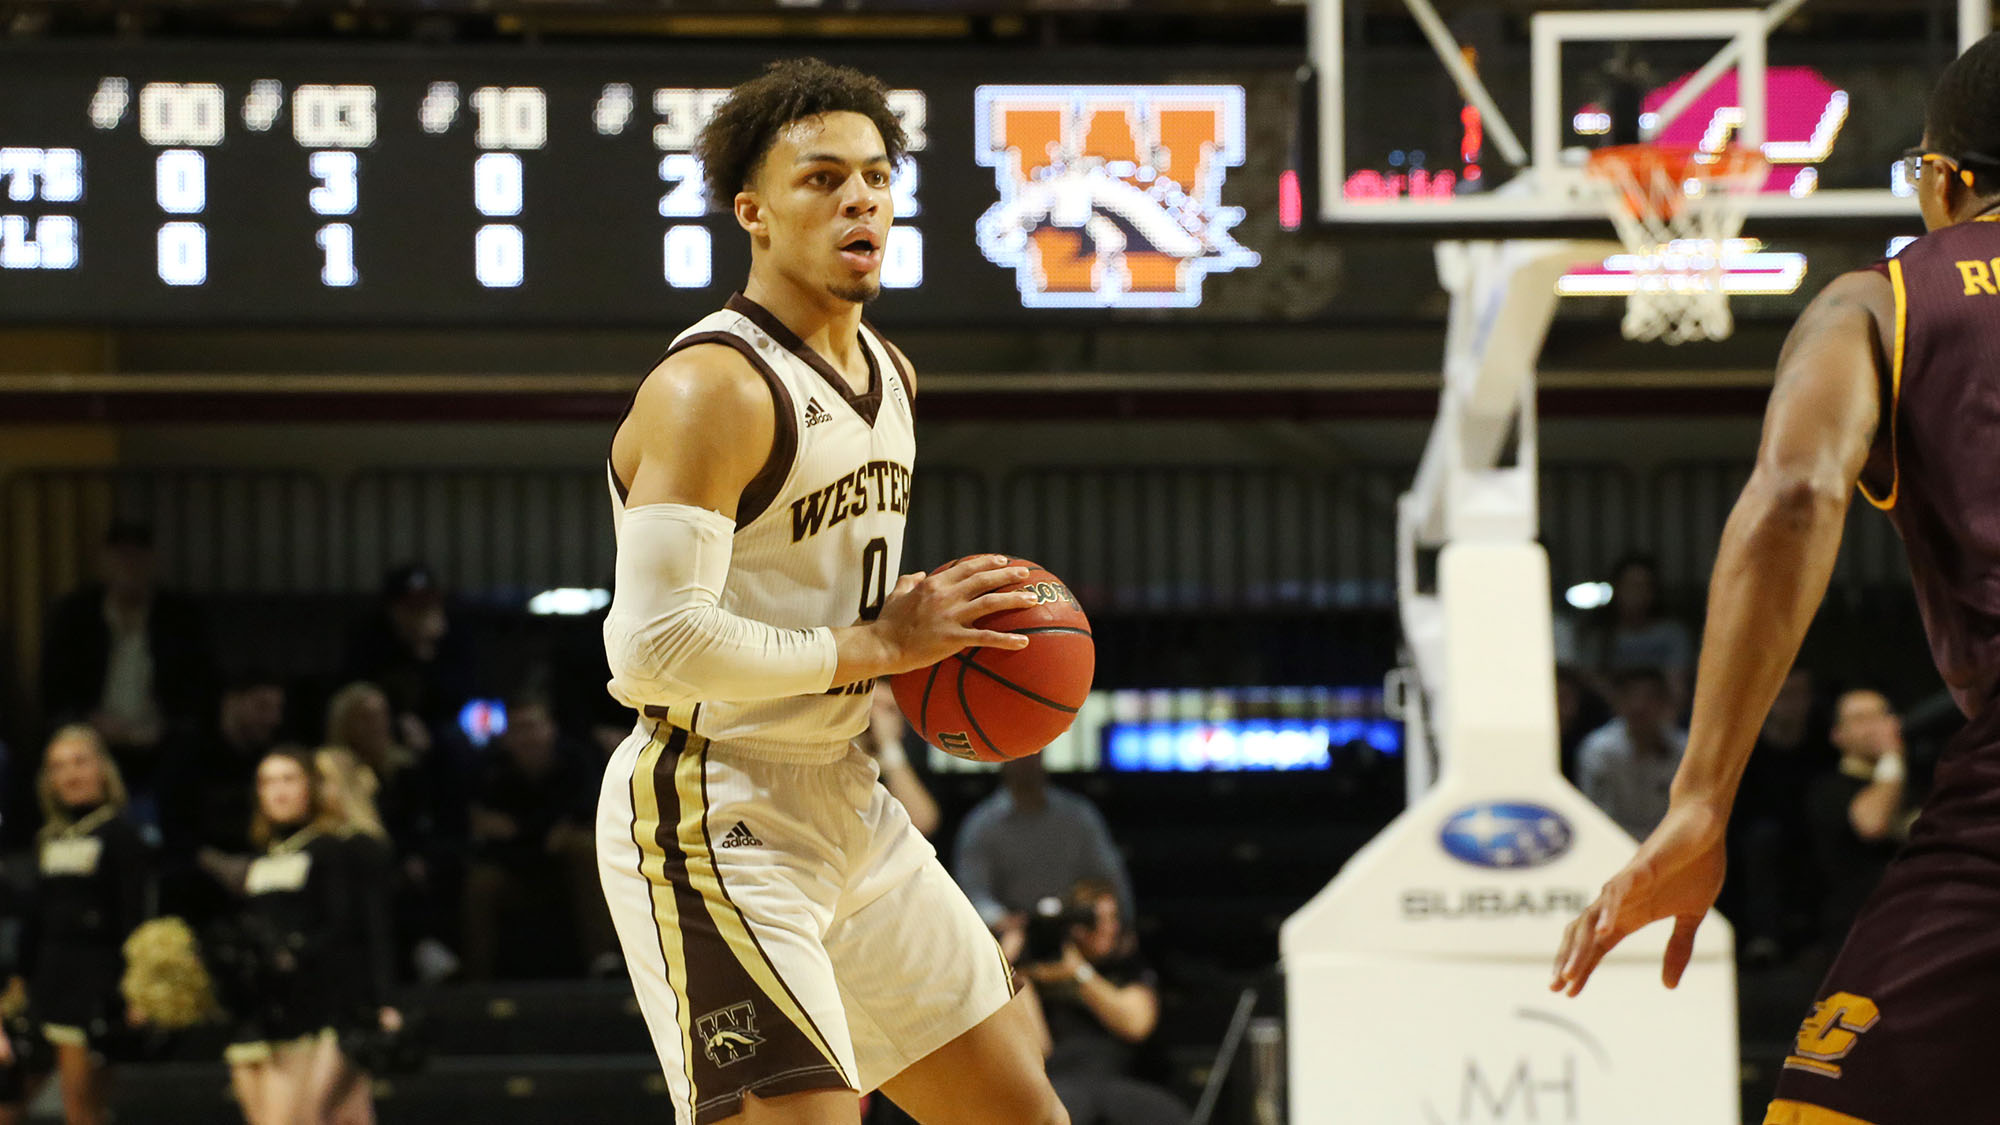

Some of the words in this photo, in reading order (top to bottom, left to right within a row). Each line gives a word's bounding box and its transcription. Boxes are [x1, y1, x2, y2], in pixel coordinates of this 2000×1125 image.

[140, 83, 225, 145] 00
[470, 87, 547, 149] 10
[156, 150, 206, 213] 0
[310, 152, 357, 214] 3
[475, 153, 523, 215] 0
[659, 154, 706, 217] 2
[157, 221, 207, 285] 0
[316, 223, 358, 286] 1
[476, 224, 523, 287] 0
[664, 225, 711, 288] 0
[860, 537, 888, 621] 0
[722, 834, 763, 849] adidas
